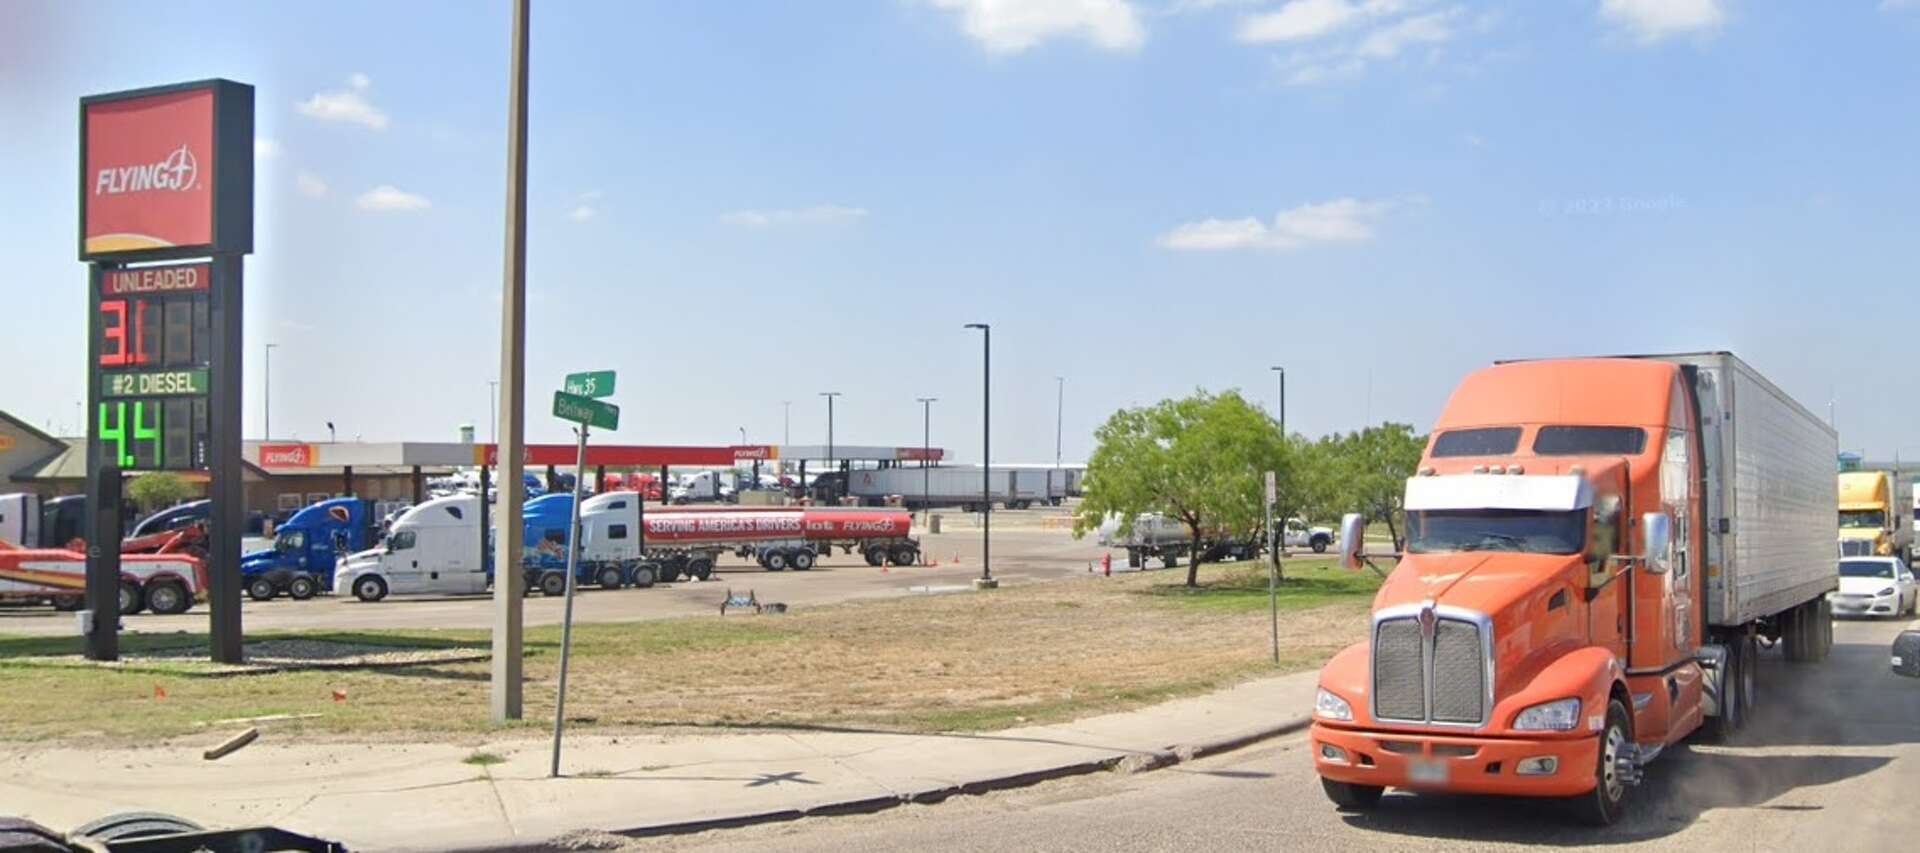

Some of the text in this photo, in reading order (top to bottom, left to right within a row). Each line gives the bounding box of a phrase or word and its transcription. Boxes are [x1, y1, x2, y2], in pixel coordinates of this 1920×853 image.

[112, 268, 198, 293] UNLEADED
[112, 372, 198, 394] #2 DIESEL
[649, 515, 801, 534] SERVING AMERICA'S DRIVERS
